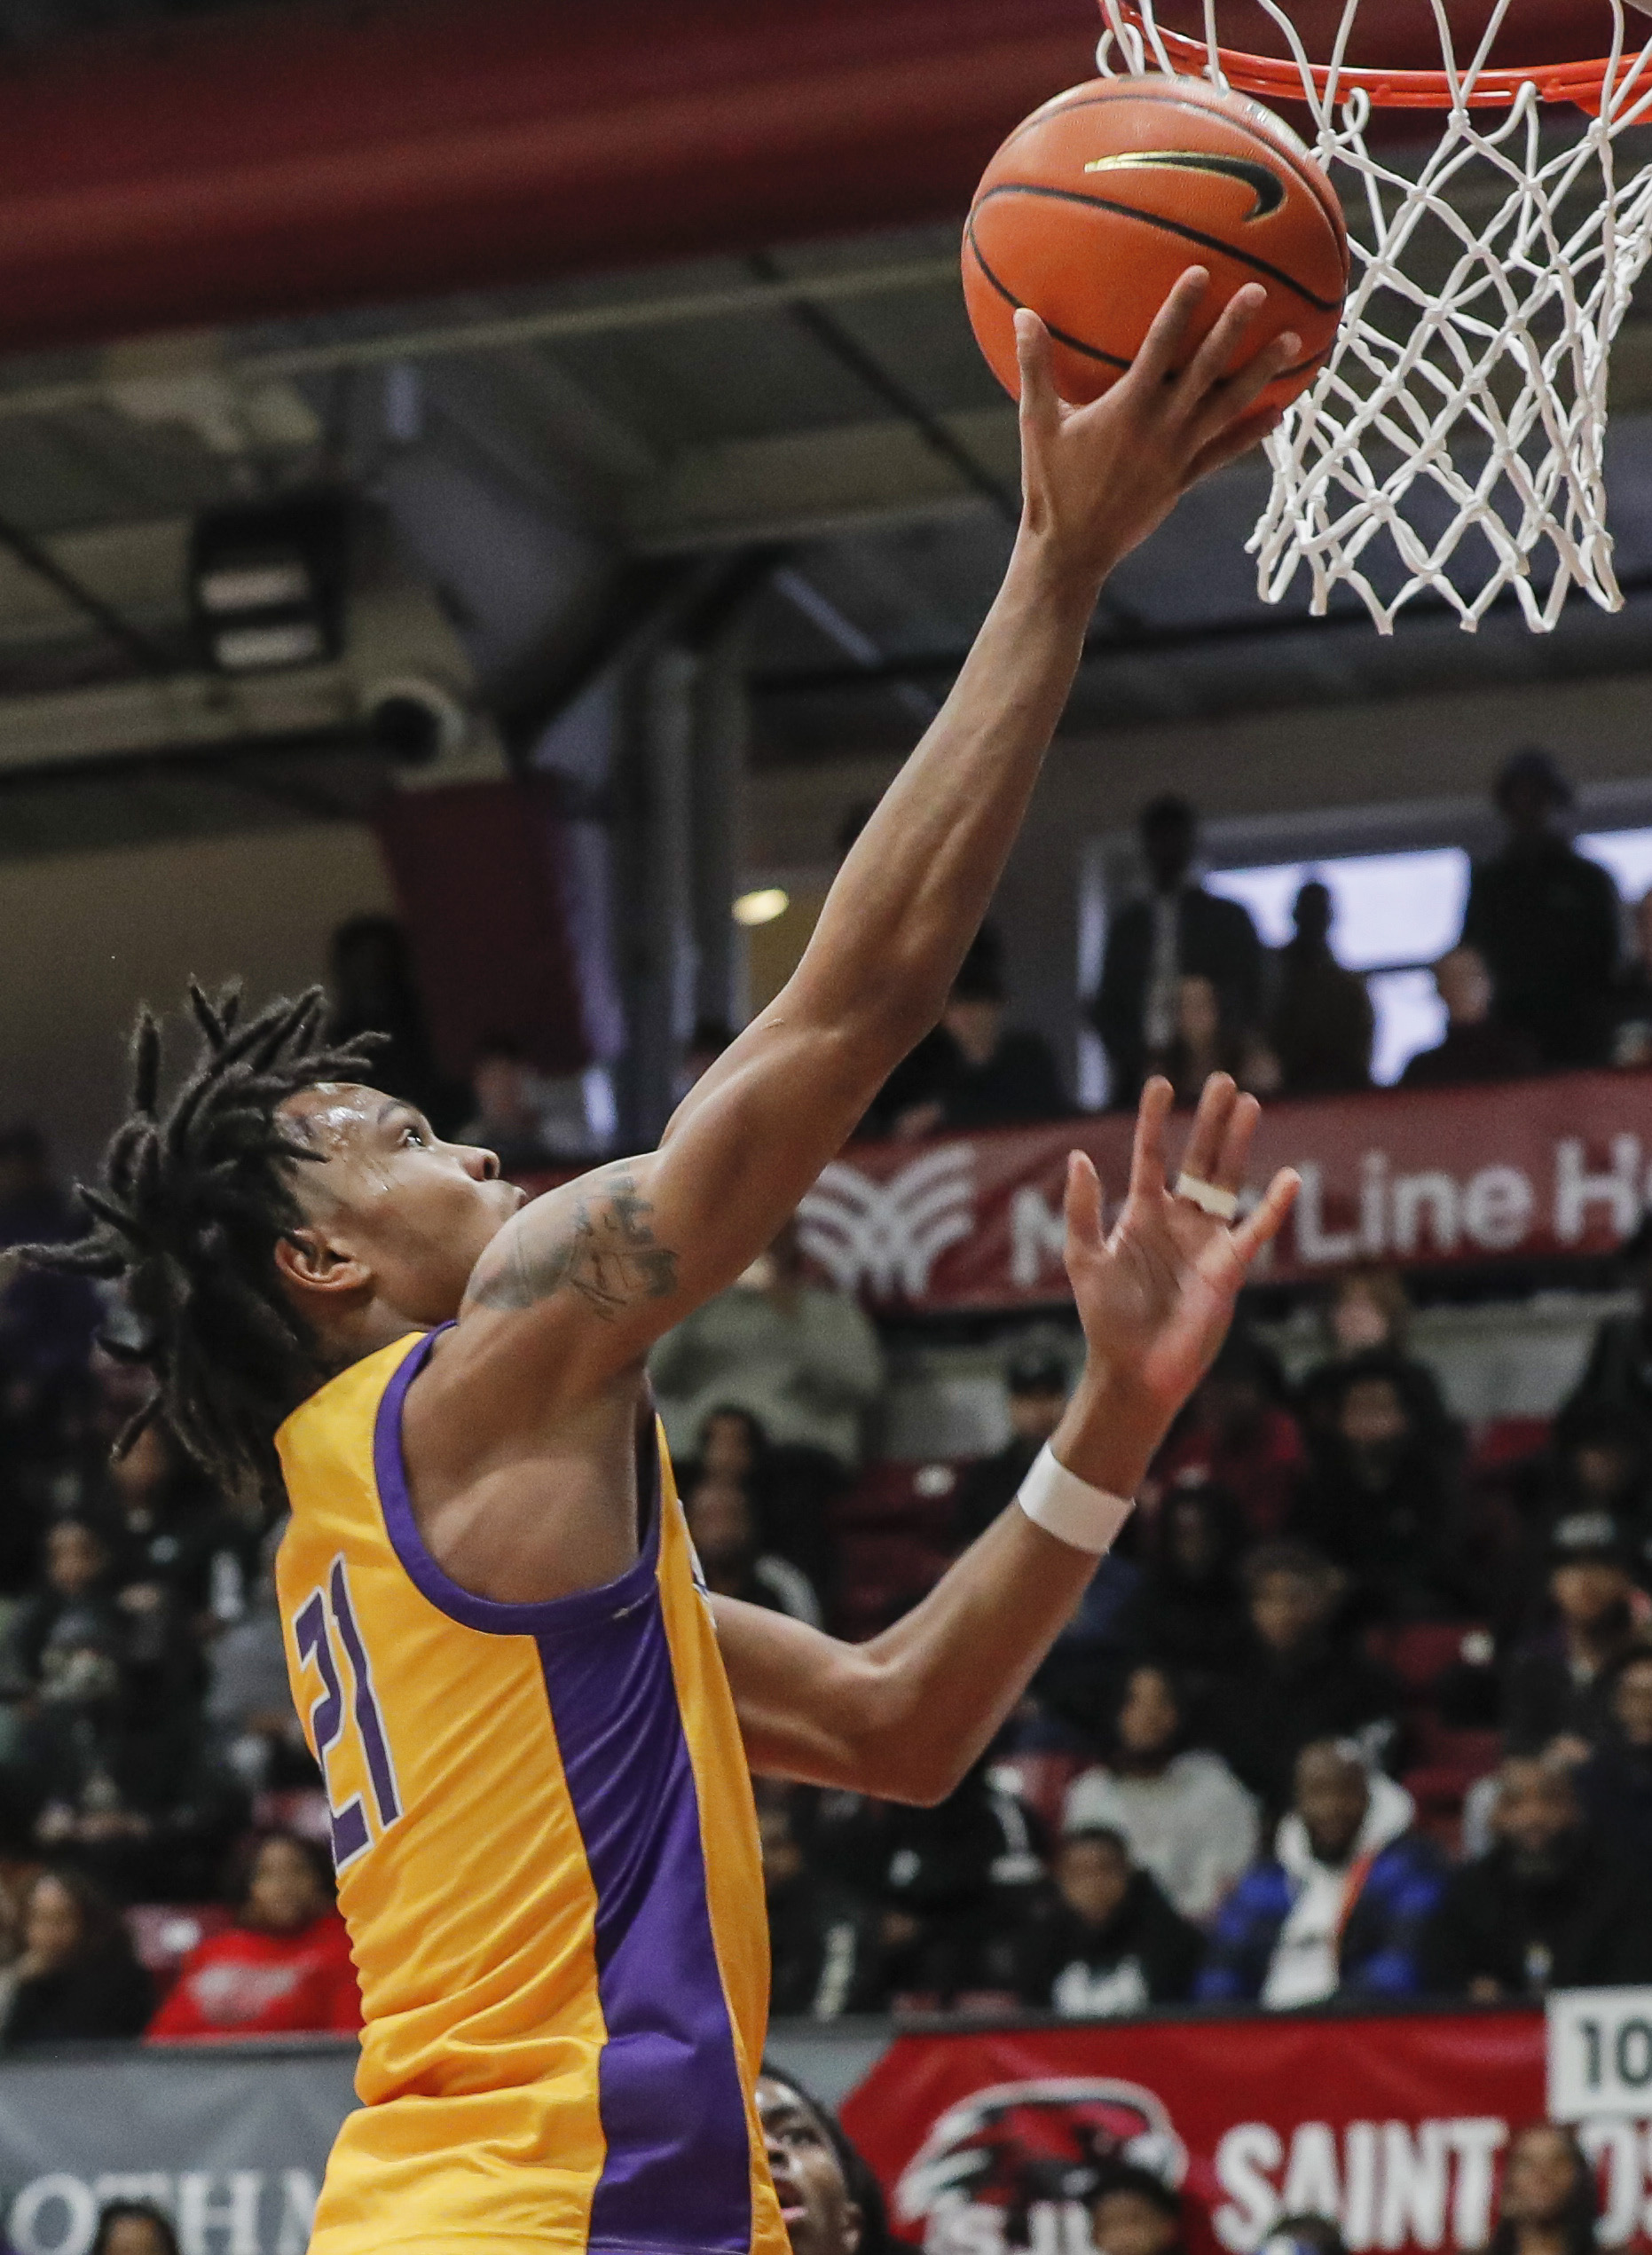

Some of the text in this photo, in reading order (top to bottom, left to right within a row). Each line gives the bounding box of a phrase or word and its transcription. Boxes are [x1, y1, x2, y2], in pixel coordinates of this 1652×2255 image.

[1296, 1153, 1532, 1263] Line
[292, 1552, 404, 1879] 21
[1212, 2116, 1510, 2253] SAINT
